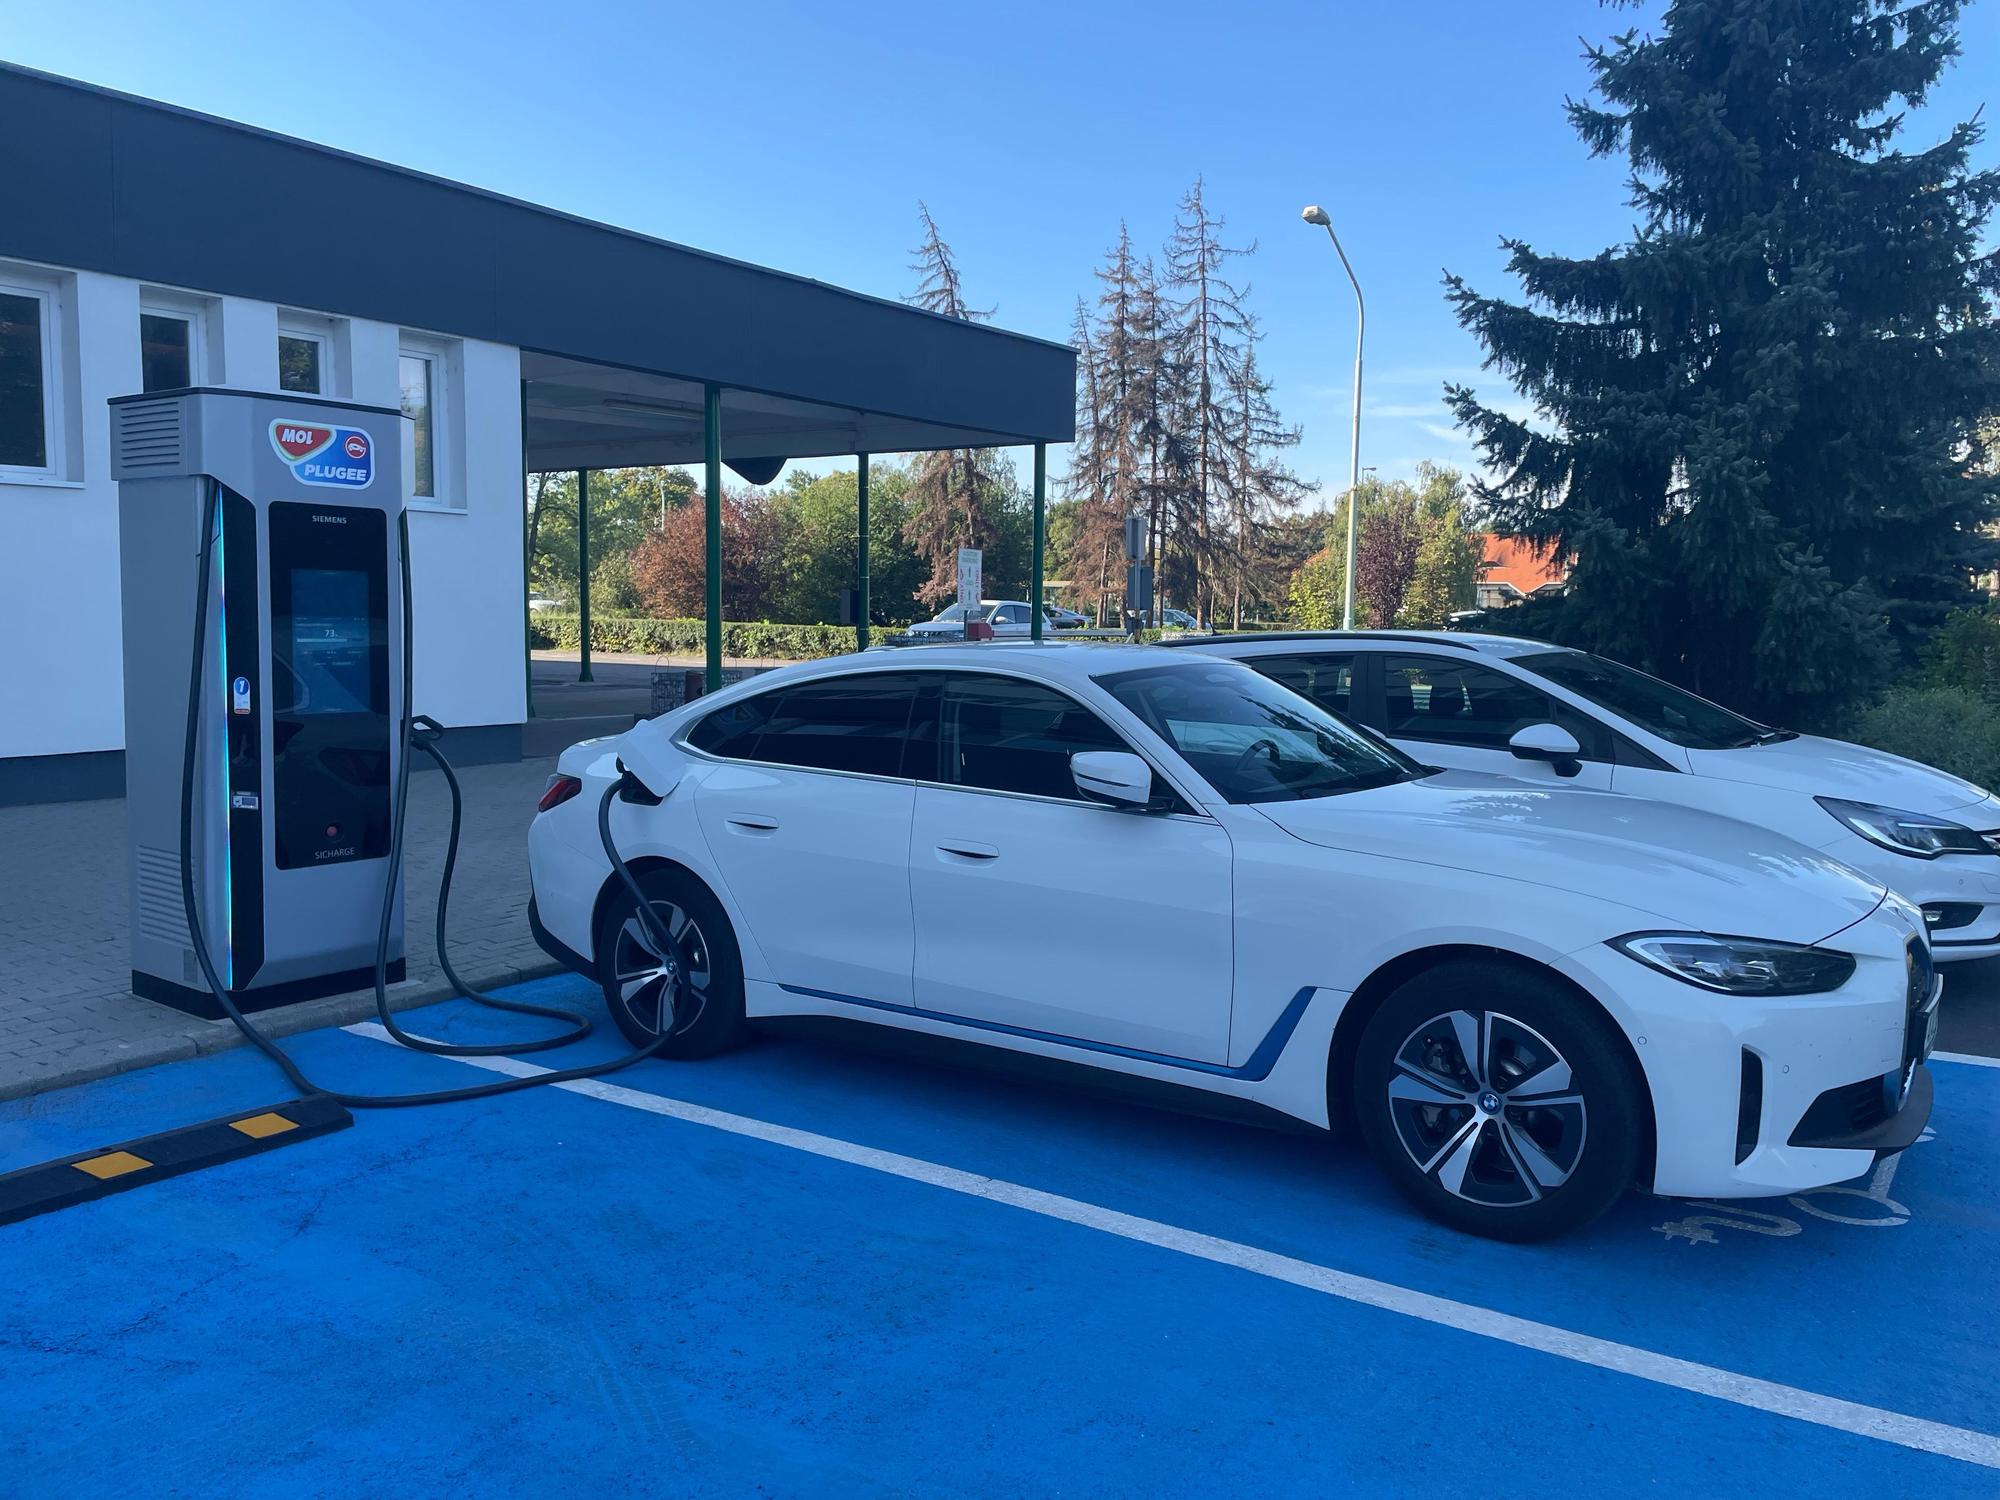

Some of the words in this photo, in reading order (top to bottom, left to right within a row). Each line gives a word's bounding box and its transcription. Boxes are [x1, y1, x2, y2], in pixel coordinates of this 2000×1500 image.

[282, 428, 313, 445] MOL
[304, 464, 367, 481] PLUGEE
[312, 515, 347, 524] SIEMENS
[314, 847, 355, 860] SICHARGE
